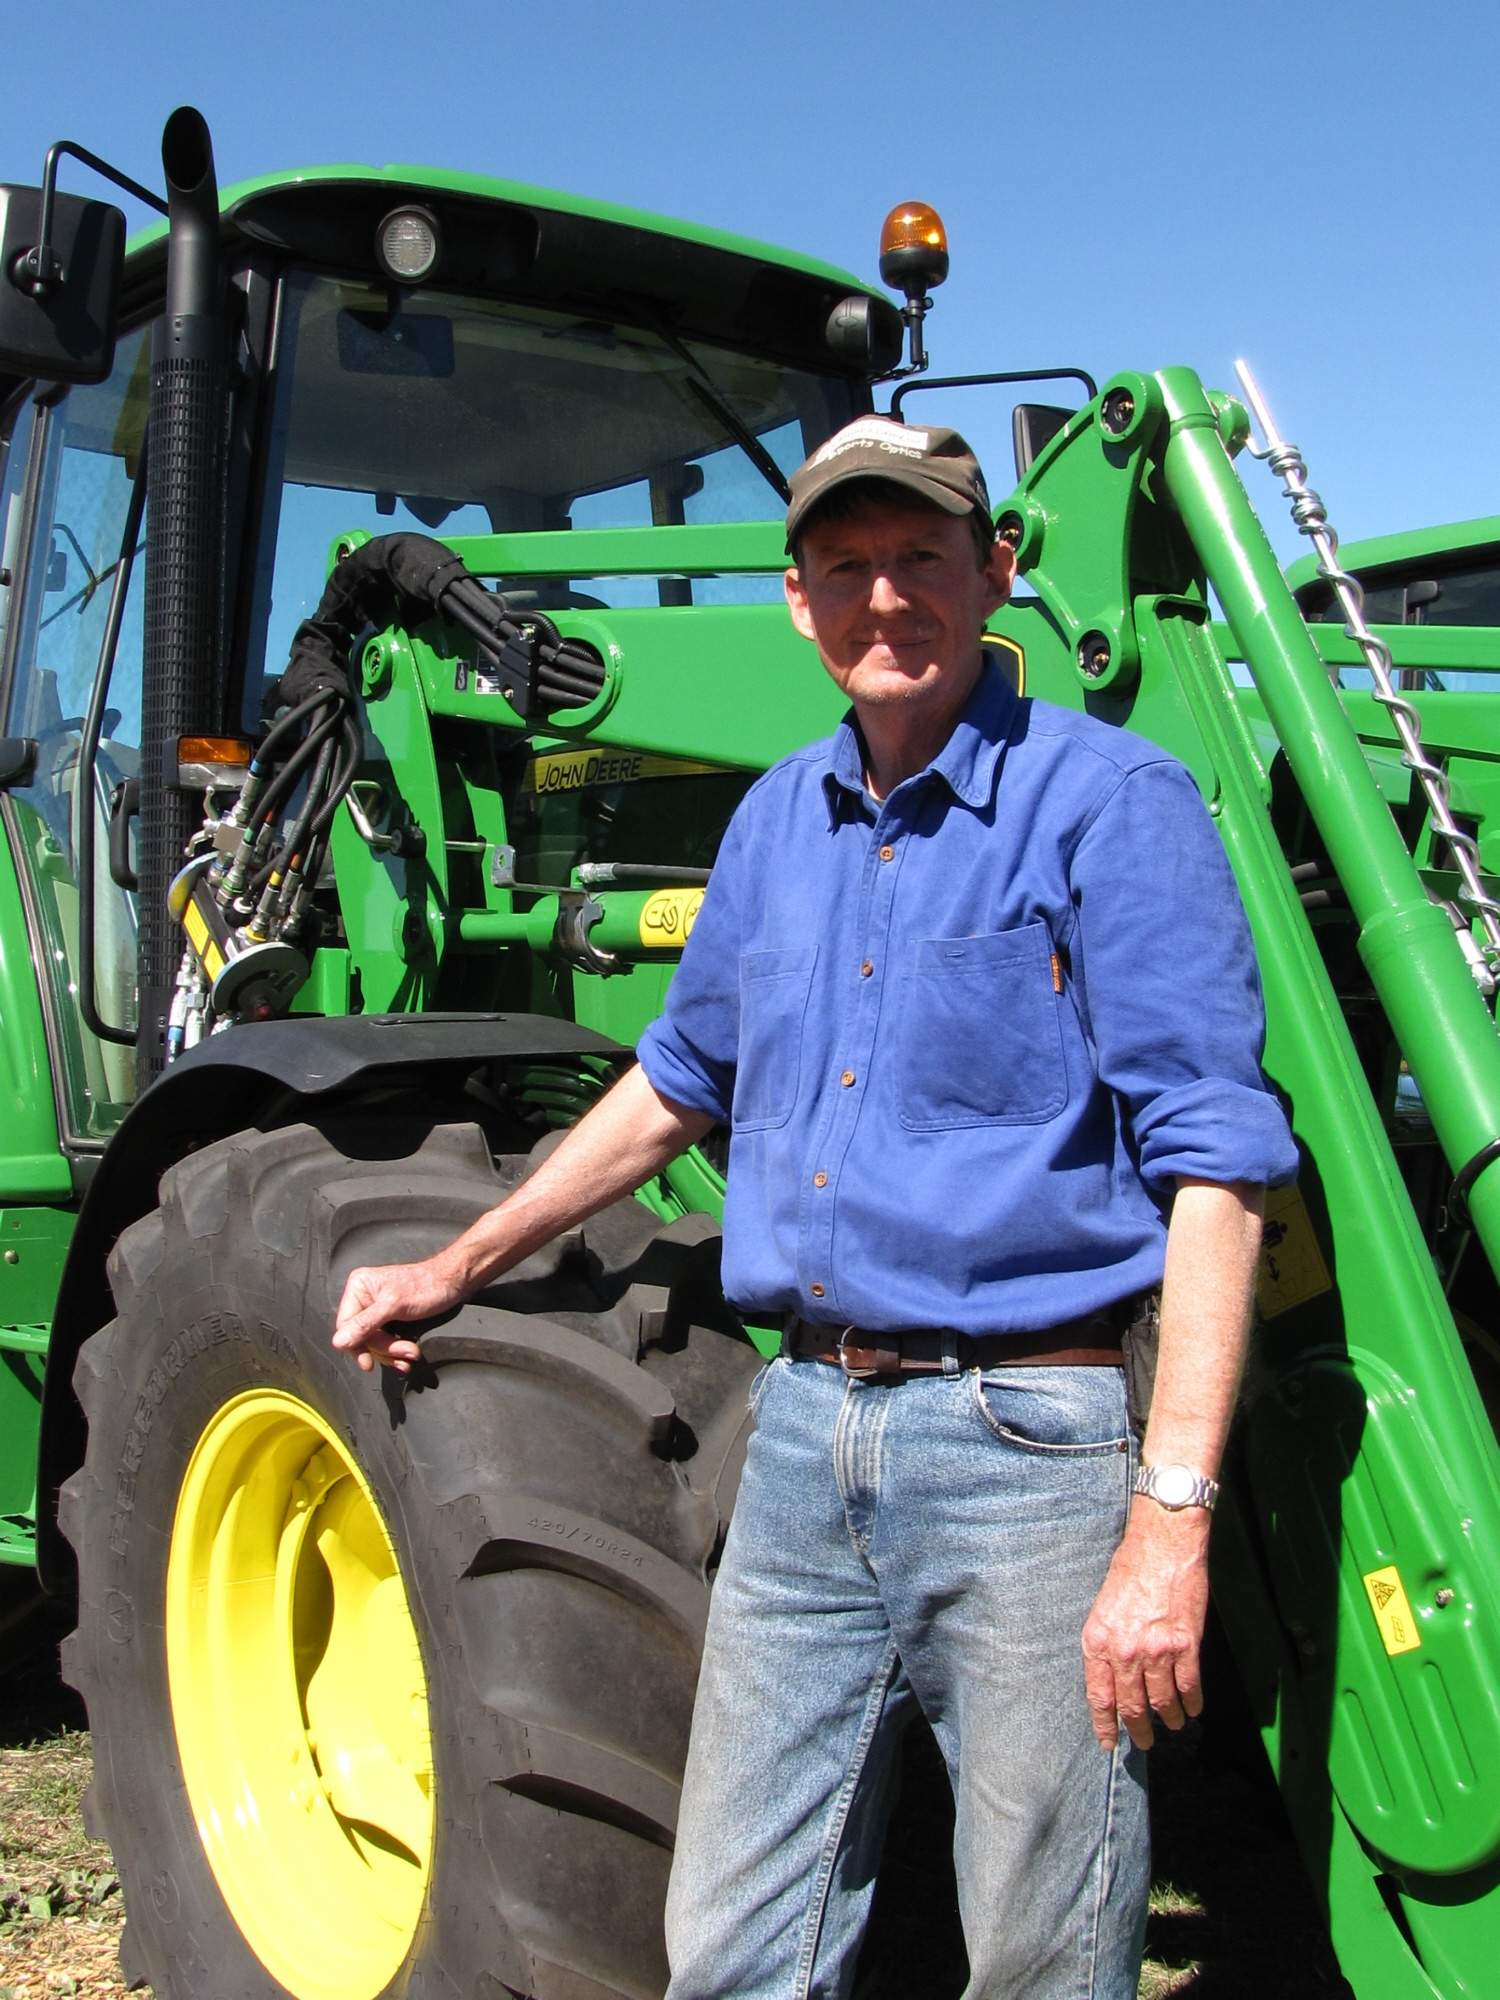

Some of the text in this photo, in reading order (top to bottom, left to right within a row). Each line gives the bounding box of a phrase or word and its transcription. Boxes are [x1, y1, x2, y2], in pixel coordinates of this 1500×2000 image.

[879, 442, 922, 459] Optics
[538, 756, 642, 790] JOHN DEERE
